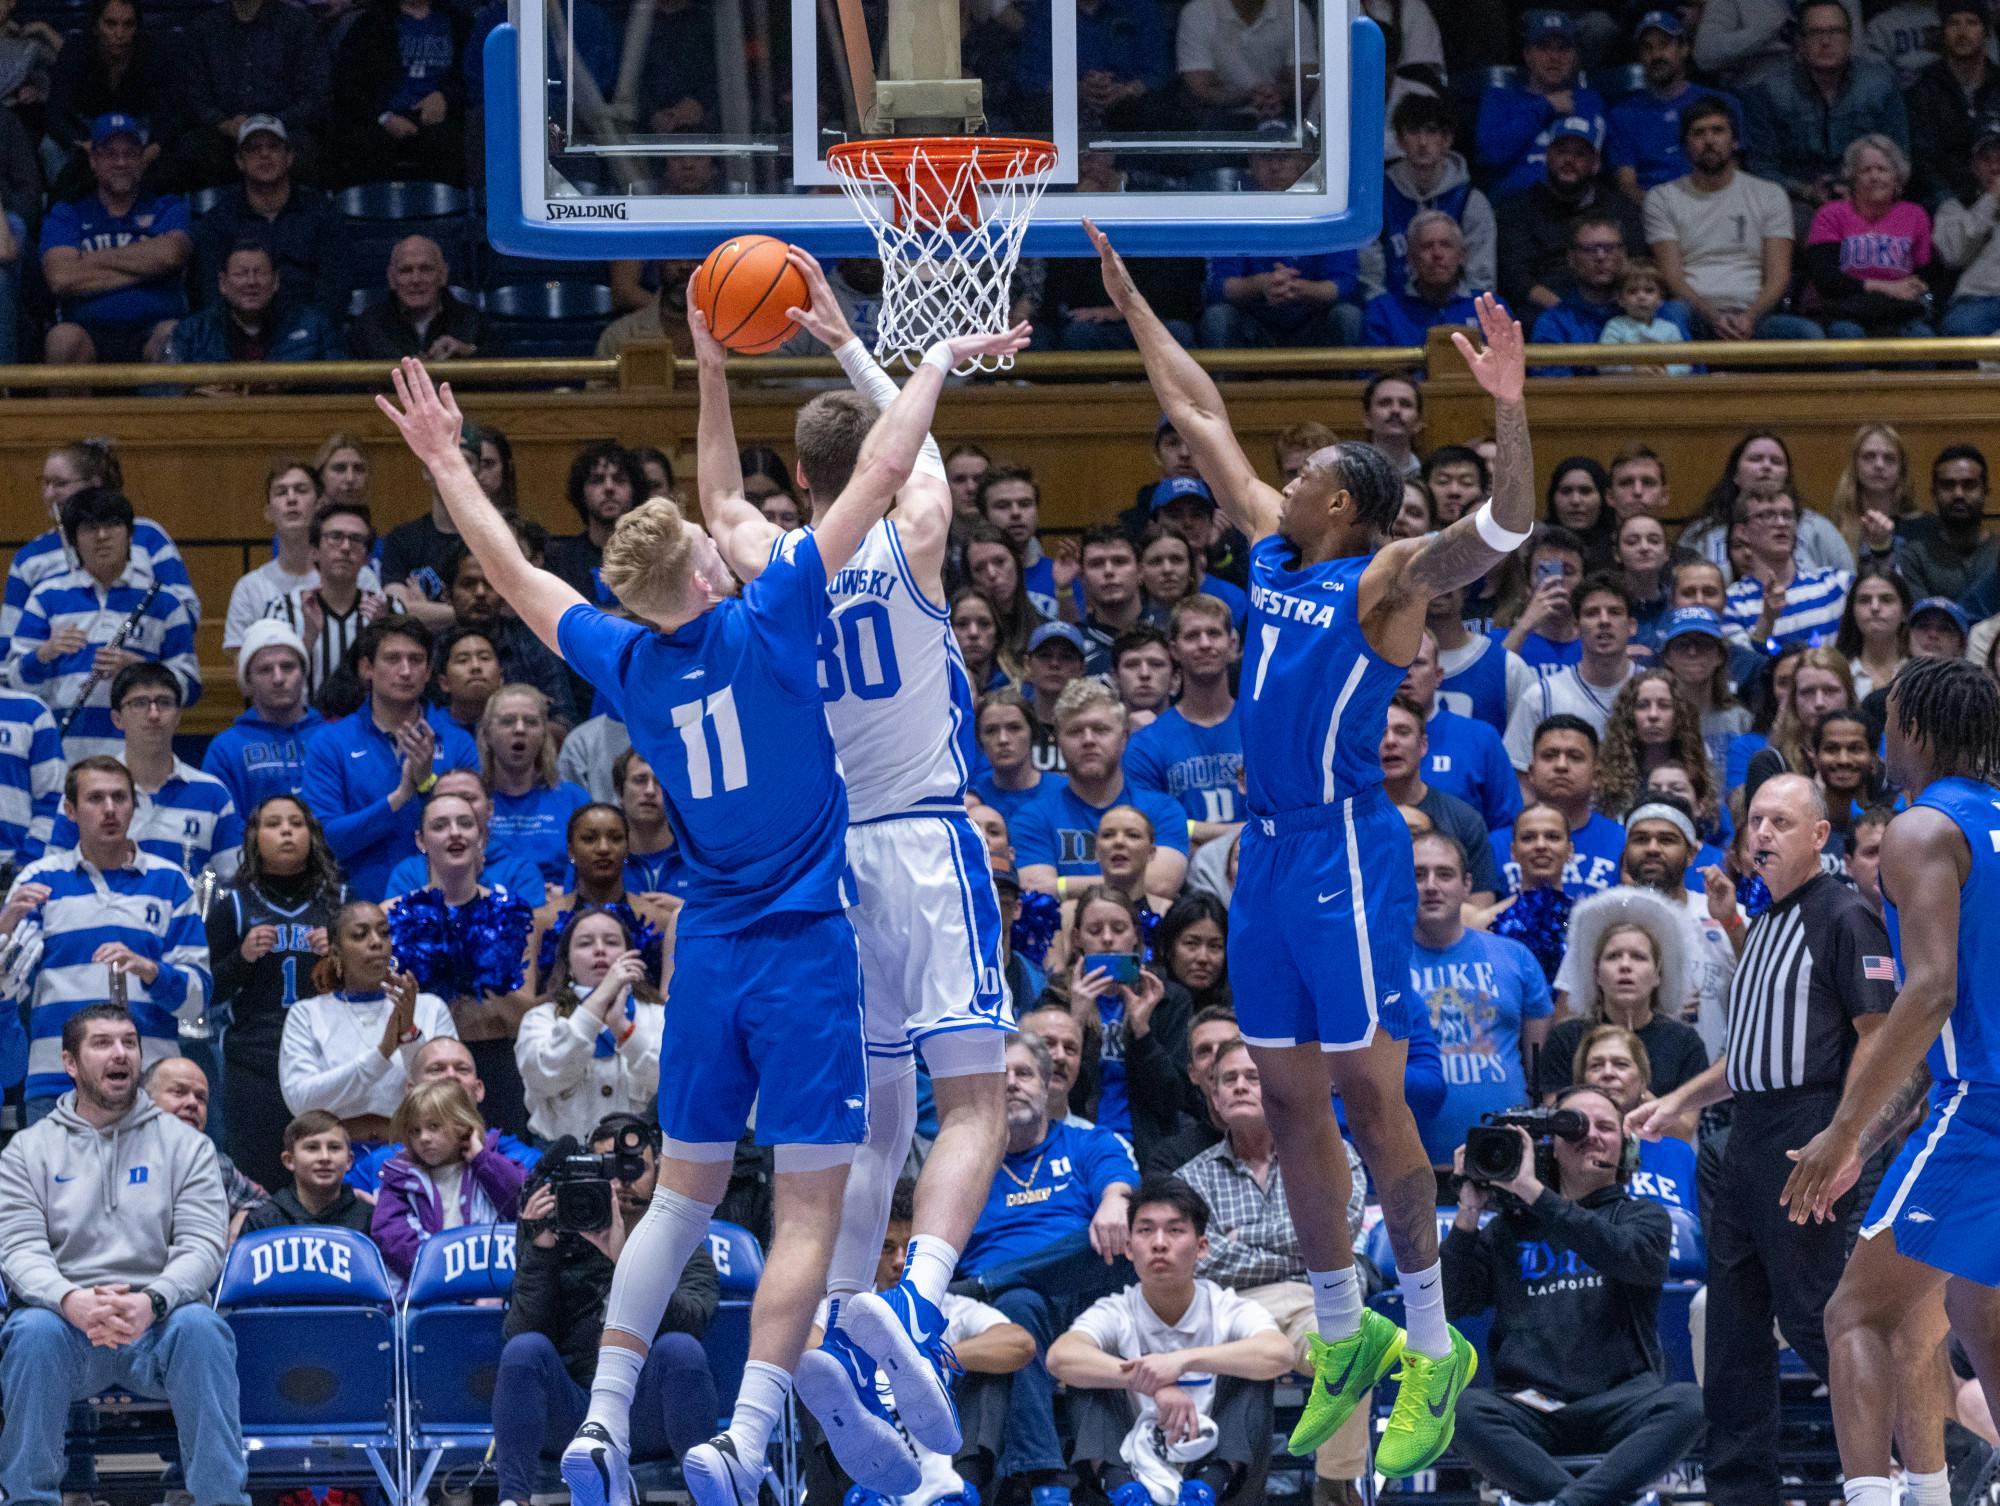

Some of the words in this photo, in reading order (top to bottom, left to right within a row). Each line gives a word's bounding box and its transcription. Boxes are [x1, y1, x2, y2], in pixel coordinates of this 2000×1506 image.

[545, 203, 625, 221] SPALDING
[830, 569, 898, 600] OWSKI
[1254, 623, 1281, 701] 1
[243, 741, 304, 764] DU
[671, 684, 748, 800] 11
[1168, 753, 1242, 798] DUK
[1432, 755, 1452, 772] D
[1503, 853, 1616, 893] DKE
[281, 955, 299, 1009] 1
[980, 967, 999, 995] D
[1440, 1052, 1506, 1086] OPS
[128, 1166, 149, 1185] D
[1624, 1172, 1681, 1204] KE
[250, 1236, 351, 1286] DUKE
[443, 1234, 516, 1284] DUK
[1517, 1240, 1600, 1281] Du
[1528, 1275, 1604, 1297] LACROSSE
